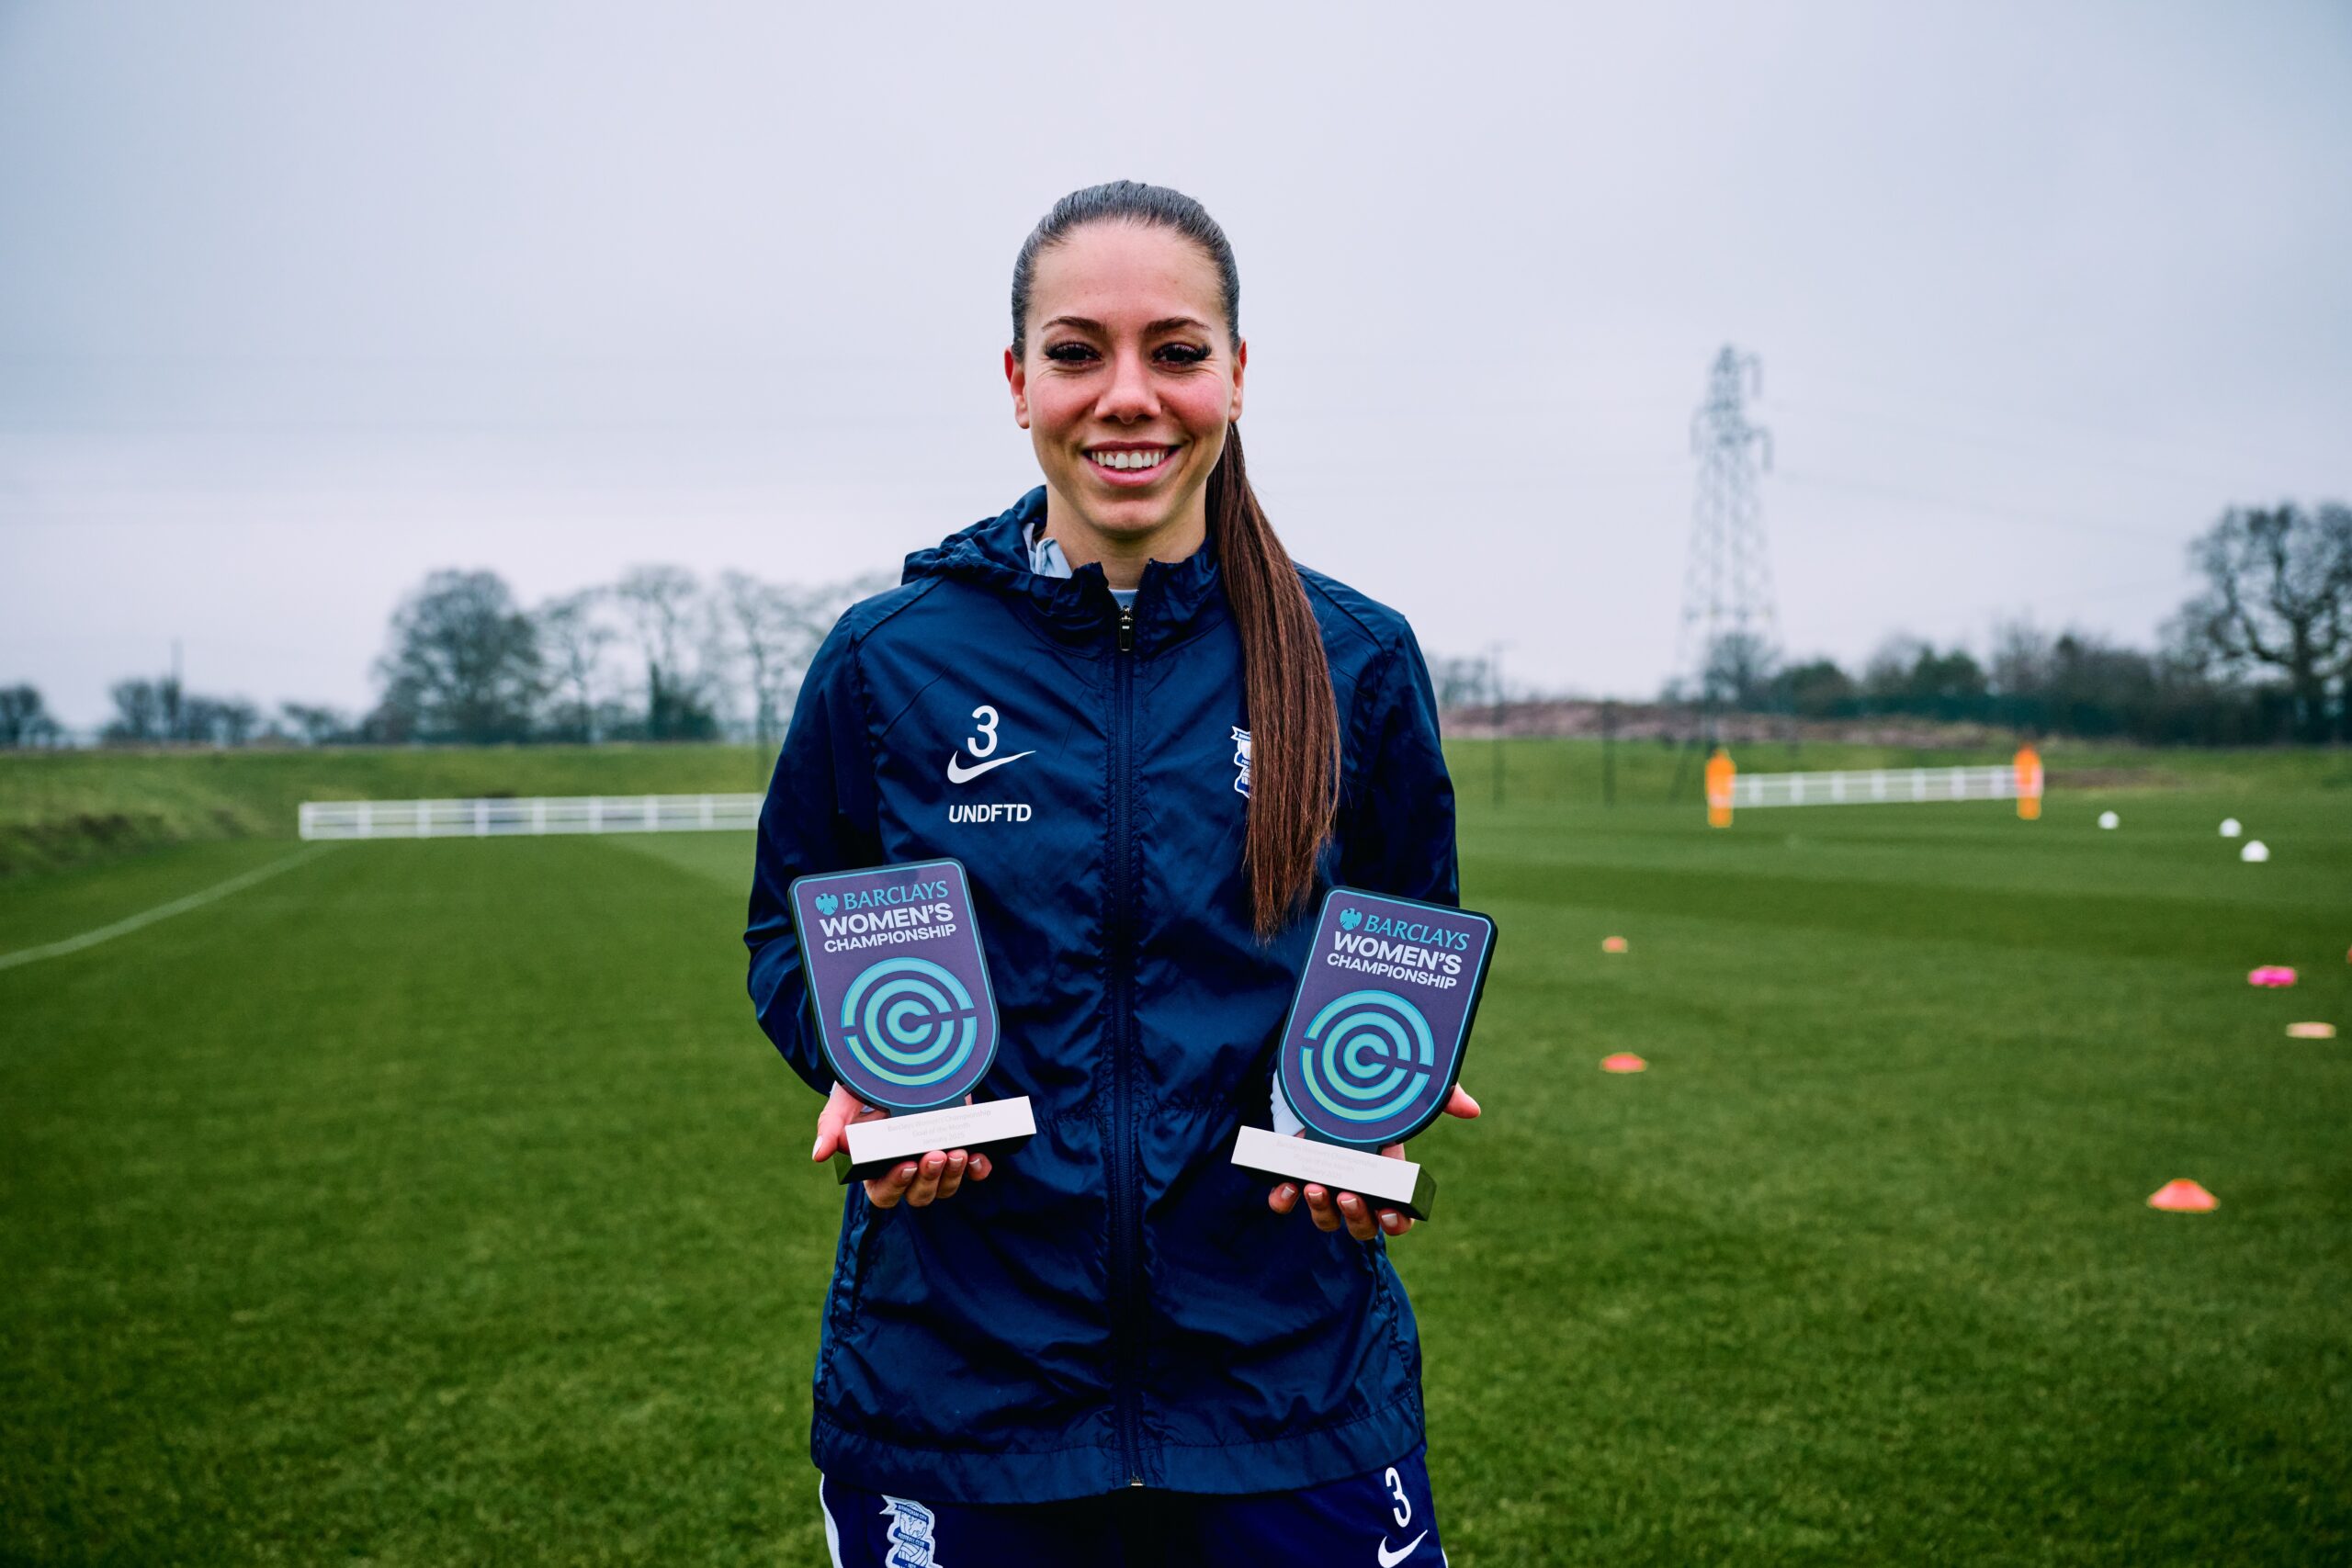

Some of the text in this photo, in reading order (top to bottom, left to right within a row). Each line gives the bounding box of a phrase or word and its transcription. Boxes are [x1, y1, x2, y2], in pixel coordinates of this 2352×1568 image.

[967, 705, 1000, 758] 3
[948, 804, 1032, 823] UNDFTD
[842, 880, 949, 910] BARCLAYS
[820, 902, 954, 938] WOMEN'S
[823, 923, 957, 953] CHAMPIONSHIP
[1363, 915, 1470, 951] BARCLAYS
[1327, 953, 1457, 989] CHAMPIONSHIP
[1334, 931, 1463, 975] WOMEN'S
[1385, 1467, 1411, 1528] 3
